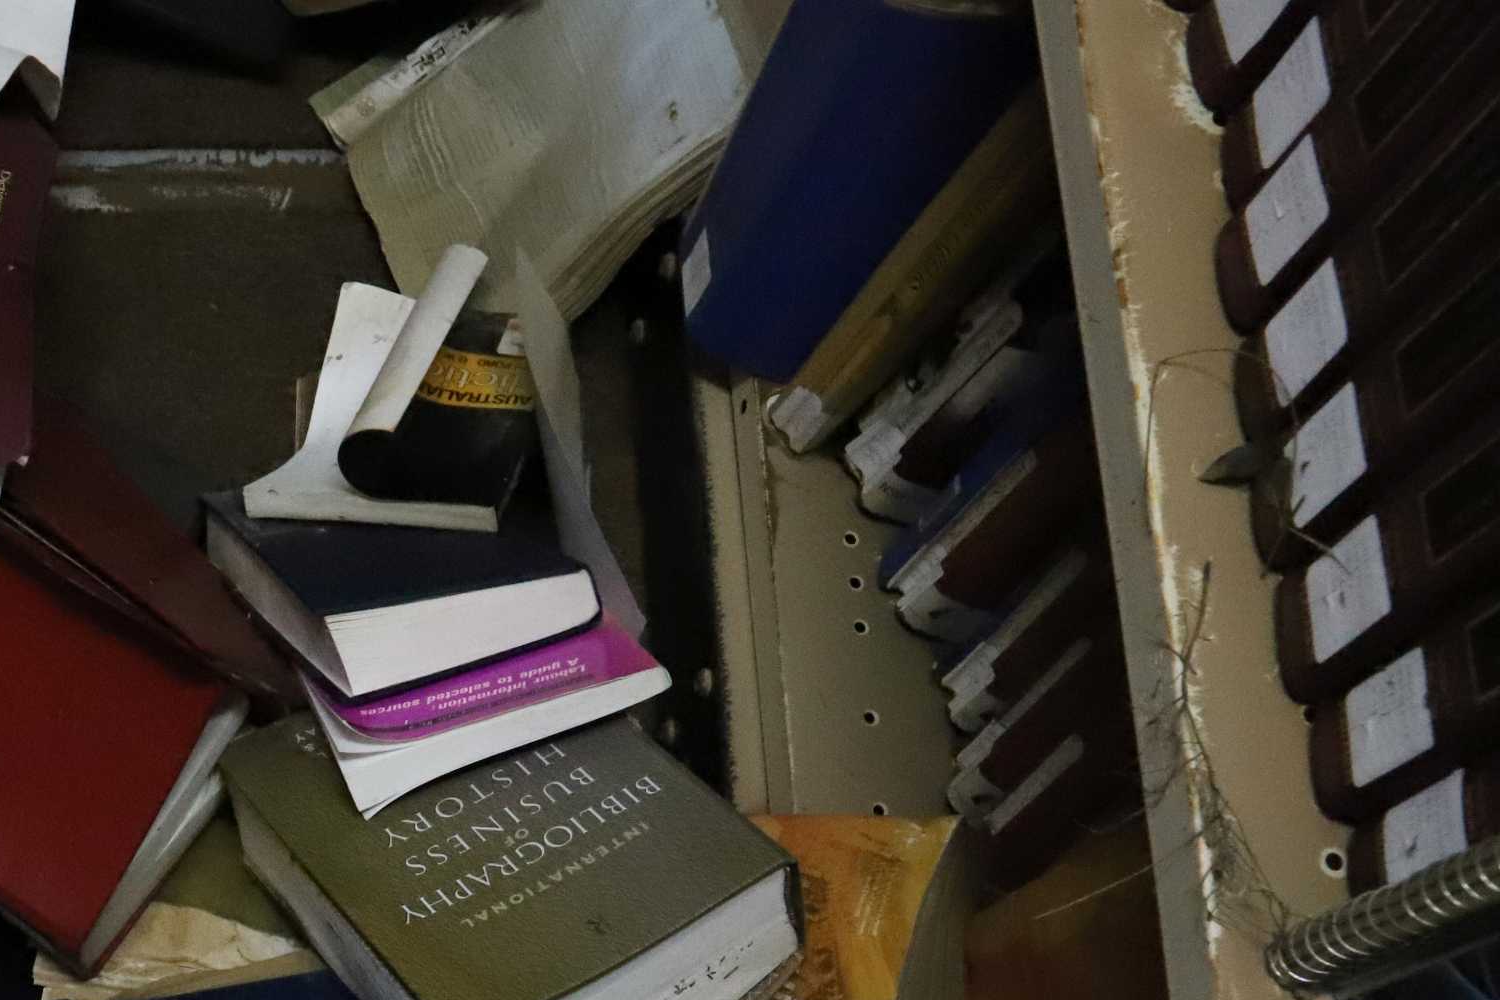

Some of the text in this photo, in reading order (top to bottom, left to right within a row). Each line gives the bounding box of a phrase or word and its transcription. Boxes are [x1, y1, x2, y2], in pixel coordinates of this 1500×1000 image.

[520, 662, 559, 678] guide
[533, 662, 585, 684] Labour
[427, 680, 490, 704] selected
[360, 698, 419, 715] sources
[384, 743, 565, 847] HISTORY
[406, 766, 594, 876] BUSINESS
[505, 827, 528, 845] OF
[401, 775, 659, 923] BIBLIOGRAPHY
[459, 820, 648, 927] INTERNATIONAL
